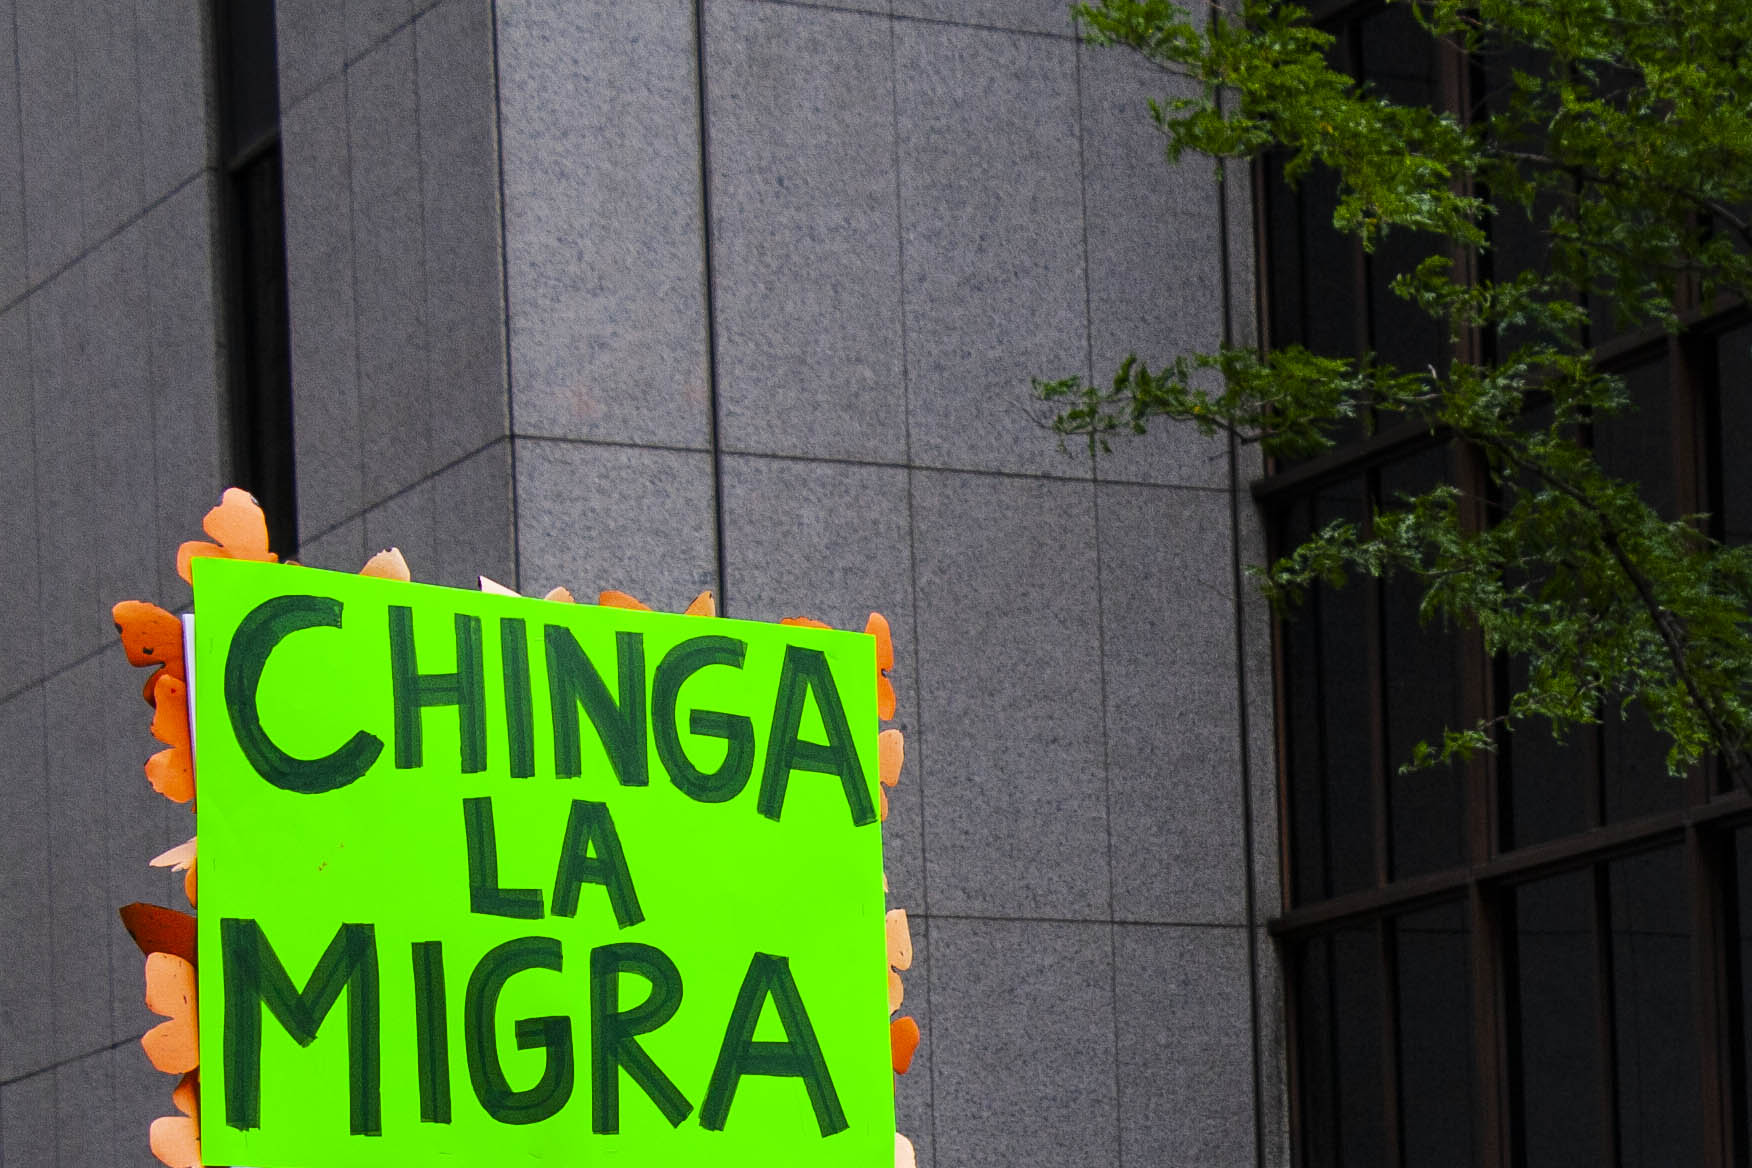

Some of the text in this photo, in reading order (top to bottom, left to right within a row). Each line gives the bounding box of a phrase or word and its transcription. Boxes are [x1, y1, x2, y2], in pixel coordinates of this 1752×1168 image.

[224, 594, 878, 827] CHINGA
[463, 797, 645, 928] LA
[221, 918, 849, 1138] MIGRA
